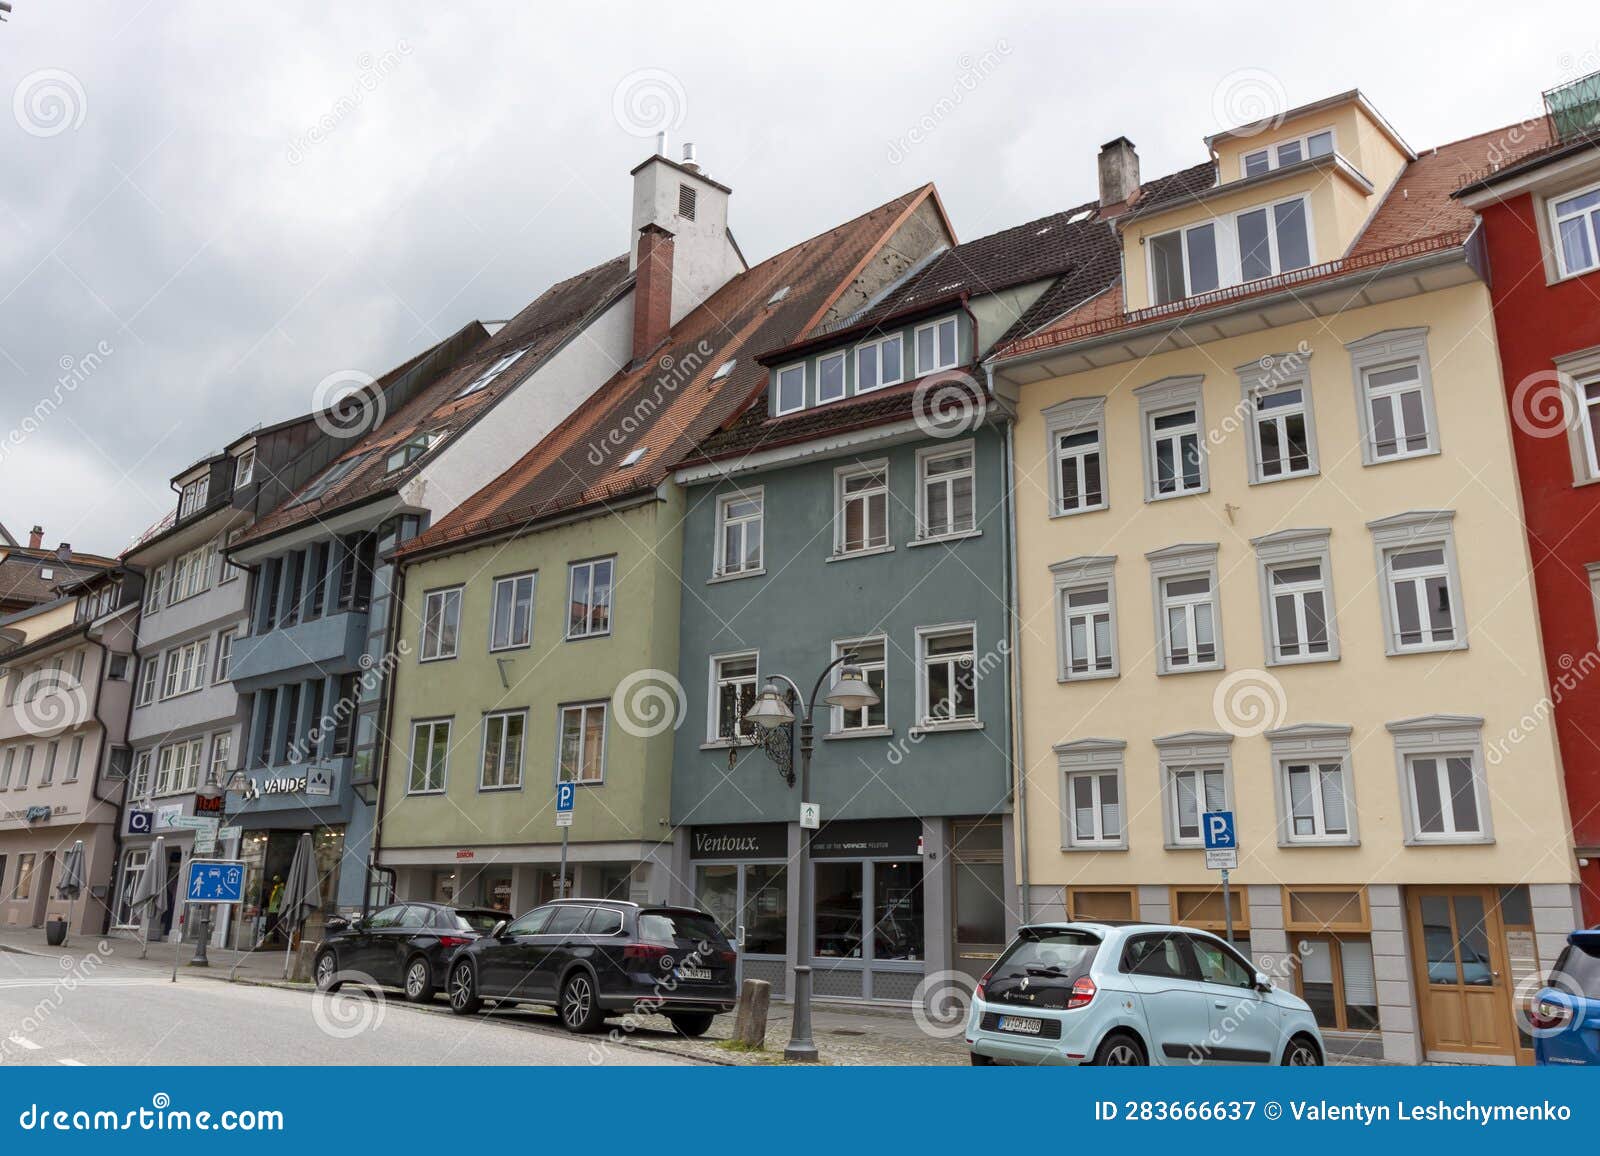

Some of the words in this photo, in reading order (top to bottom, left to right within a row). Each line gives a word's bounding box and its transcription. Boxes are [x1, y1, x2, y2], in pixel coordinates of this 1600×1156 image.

[560, 786, 571, 808] P
[1210, 816, 1227, 845] P
[695, 833, 759, 852] Ventoux.
